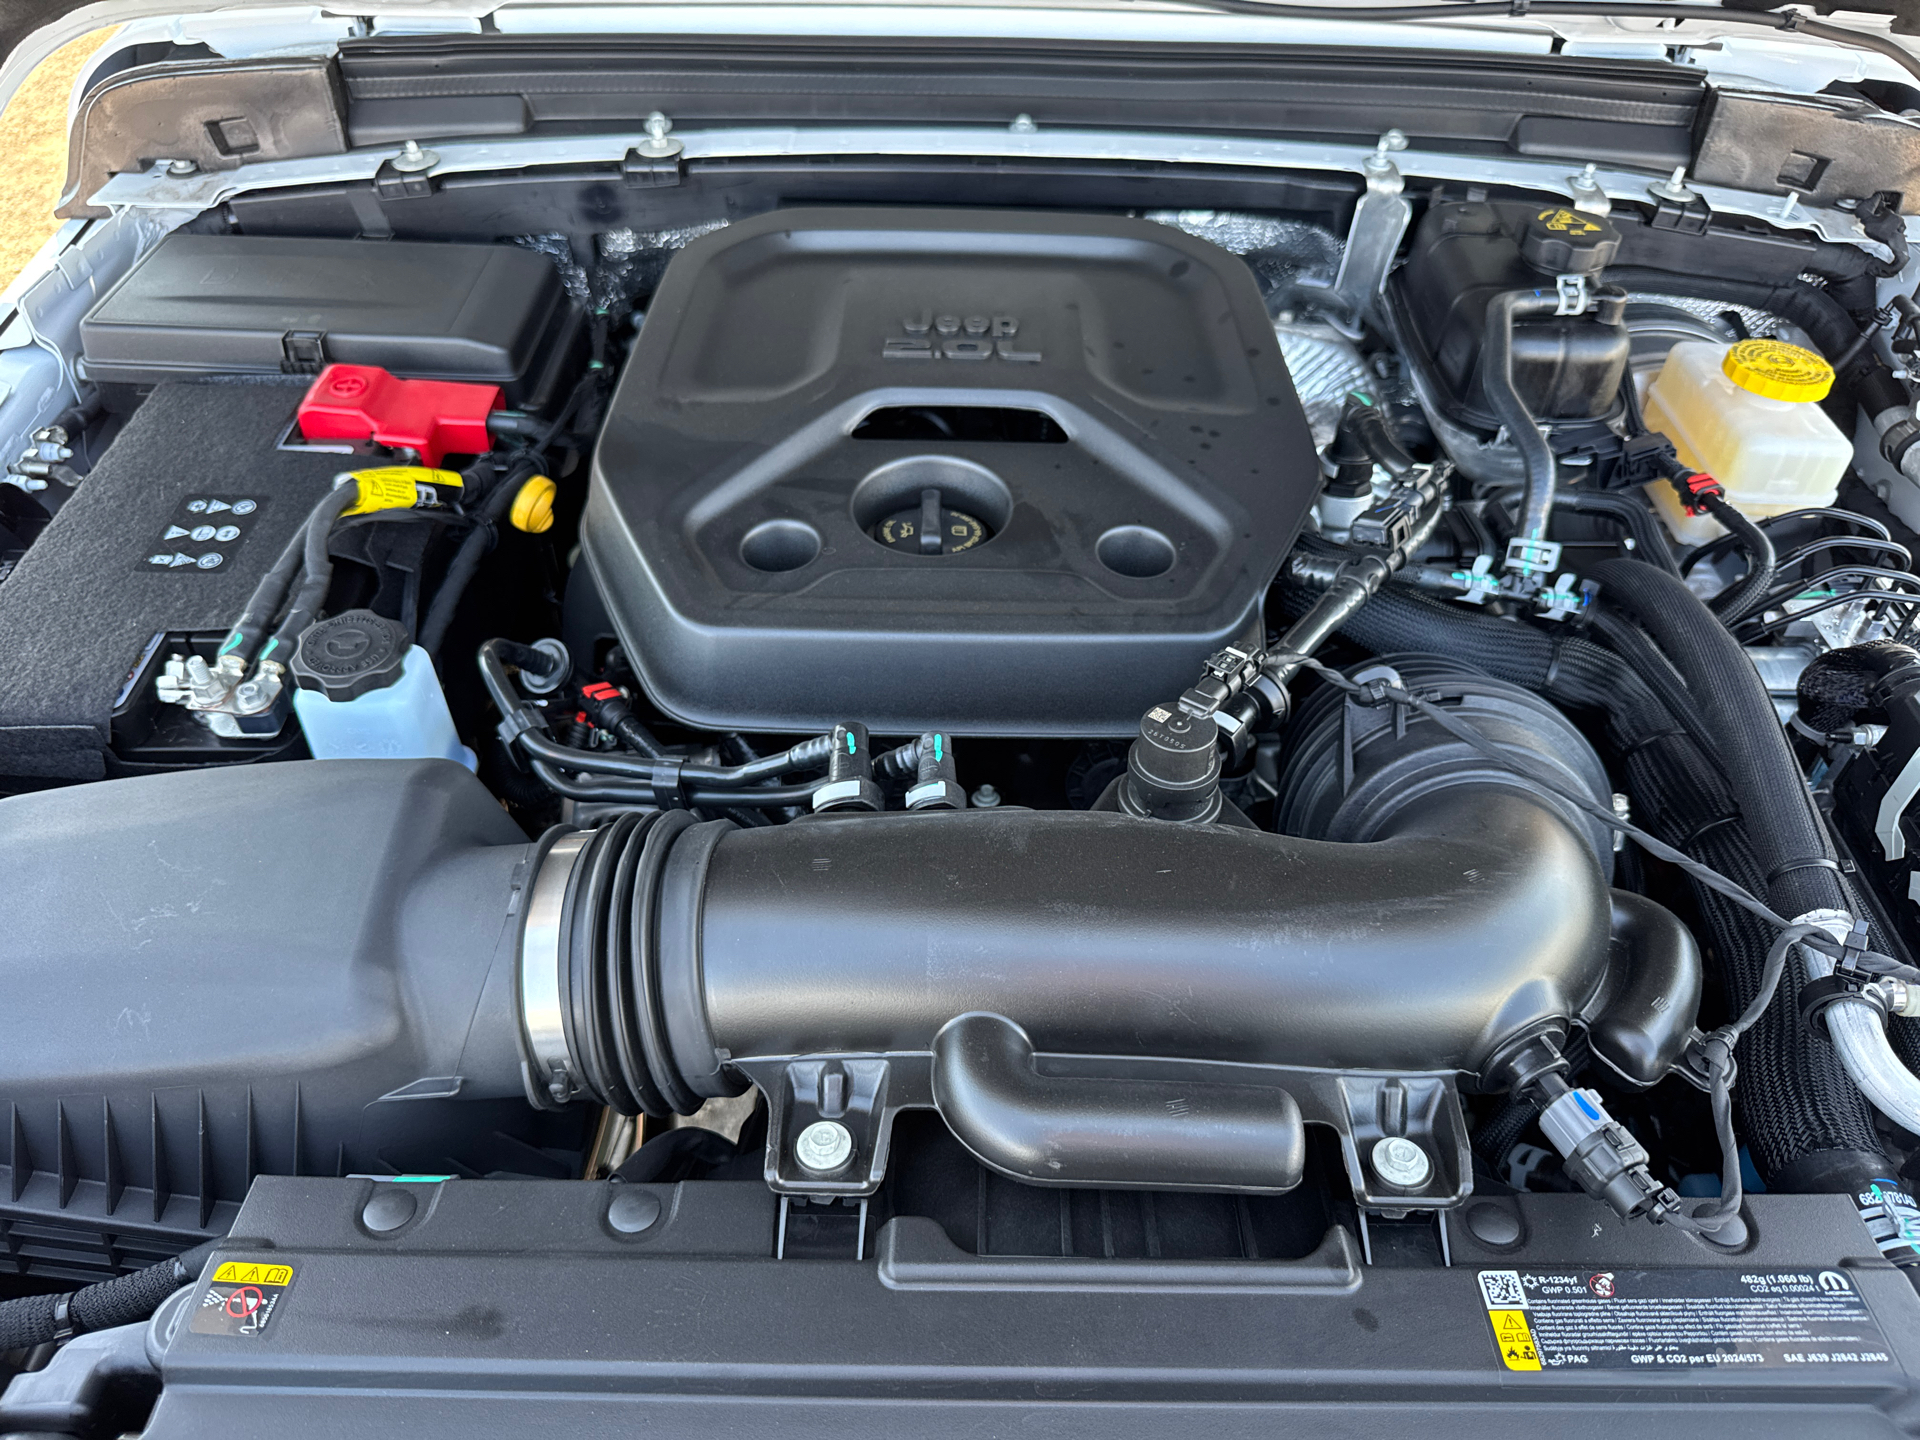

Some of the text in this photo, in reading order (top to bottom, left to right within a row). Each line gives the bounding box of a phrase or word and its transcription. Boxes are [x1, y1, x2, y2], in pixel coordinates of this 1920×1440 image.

[903, 309, 1019, 337] Jeep
[882, 339, 1042, 361] 2.0L
[1538, 1275, 1814, 1285] R-1234yf 482g (1.060 lb)
[1541, 1286, 1563, 1294] GWP
[1565, 1286, 1588, 1294] 0.501
[1750, 1285, 1770, 1293] CO2
[1771, 1286, 1782, 1294] eq
[1782, 1285, 1814, 1293] 0.00024
[1567, 1354, 1588, 1364] PAG
[1631, 1354, 1655, 1364] GWP
[1657, 1354, 1665, 1364] &
[1666, 1354, 1687, 1364] CO2
[1689, 1355, 1705, 1366] per
[1706, 1353, 1721, 1363] EU
[1722, 1353, 1764, 1363] 2024/573
[1783, 1353, 1806, 1363] SAE
[1807, 1353, 1829, 1363] J639
